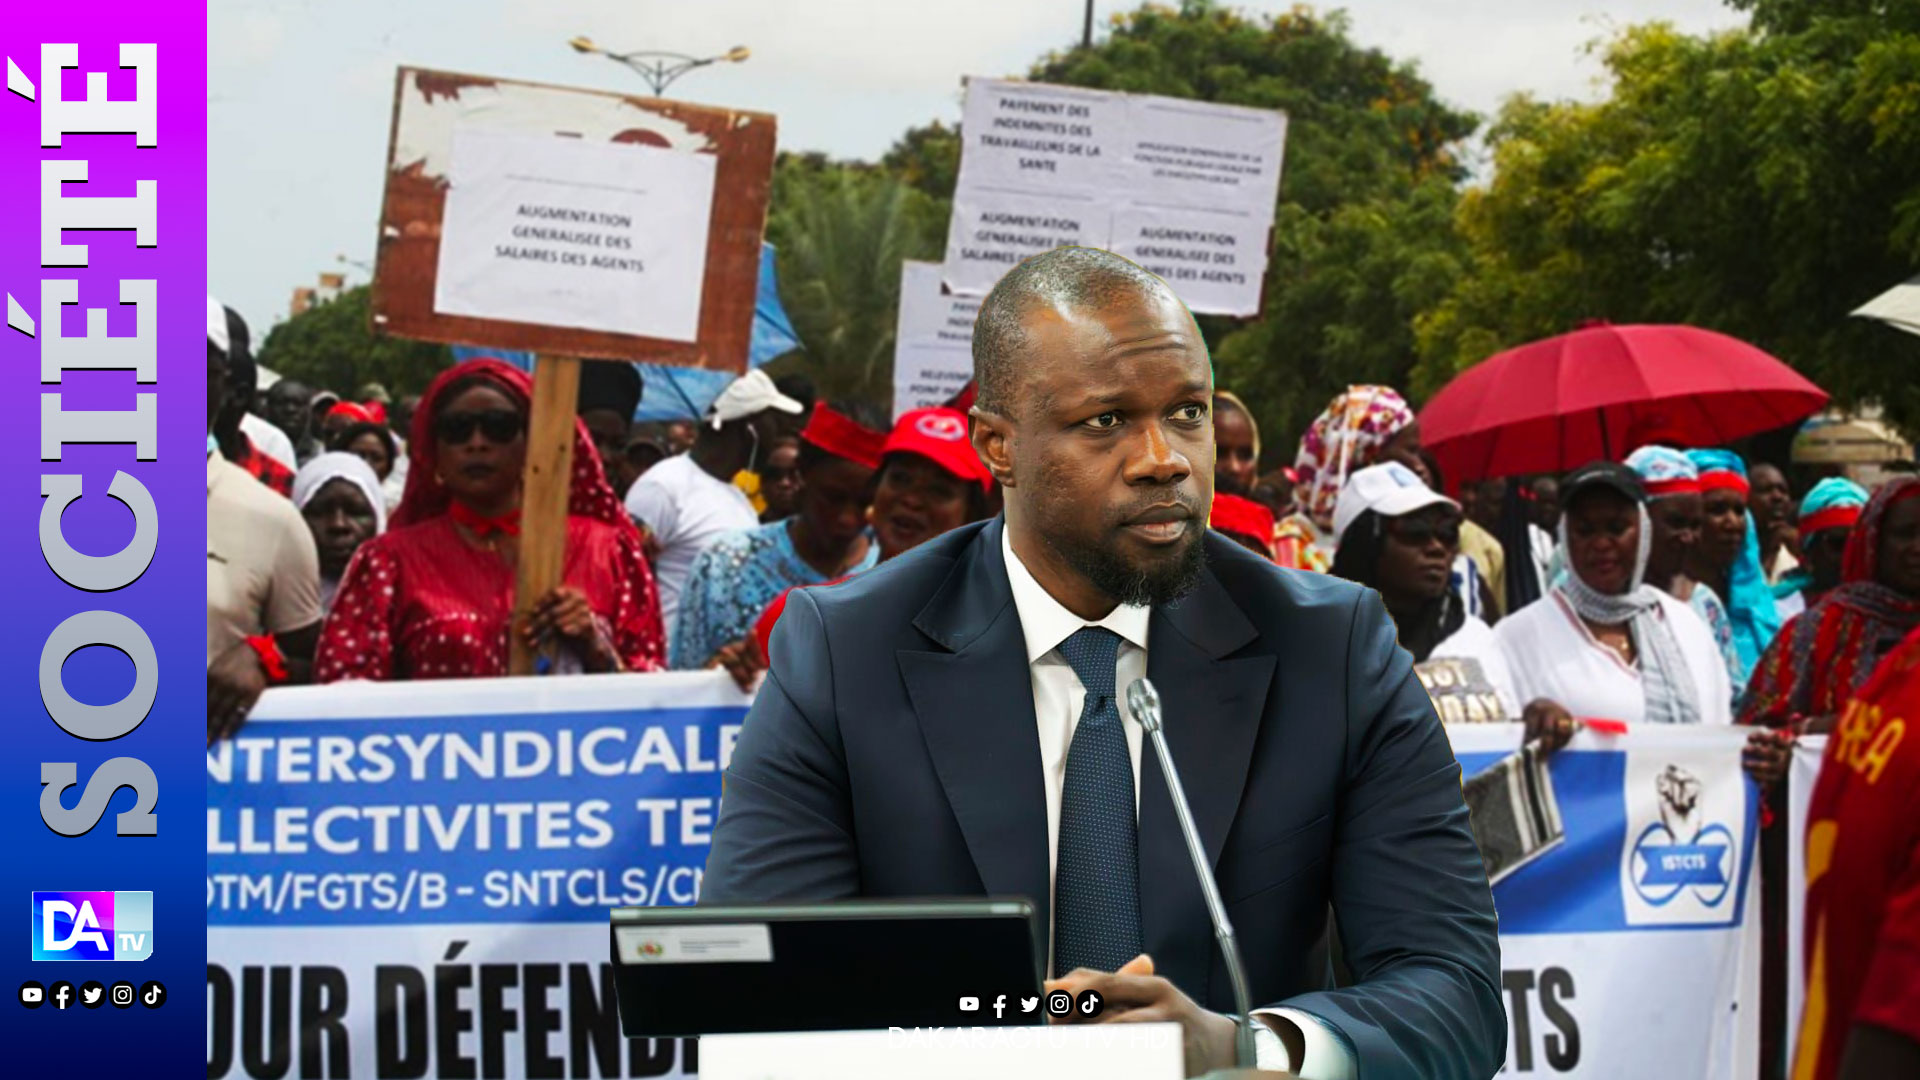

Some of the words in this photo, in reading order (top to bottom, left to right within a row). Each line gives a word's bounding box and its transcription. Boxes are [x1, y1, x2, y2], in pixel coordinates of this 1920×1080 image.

[1000, 98, 1064, 114] PAYEMENT
[1067, 104, 1090, 118] DES
[993, 117, 1066, 134] INDEMNITES
[1069, 124, 1092, 137] DES
[980, 134, 1065, 154] TRAVAILLEURS
[1067, 143, 1082, 156] DE
[1085, 145, 1101, 157] LA
[1019, 157, 1056, 172] SANTE
[517, 204, 632, 228] AUGMENTATION
[981, 212, 1079, 231] AUGMENTATION
[512, 225, 601, 247] GENERALISEE
[605, 235, 632, 249] DES
[975, 230, 1053, 248] GENERALISEE
[1140, 227, 1236, 245] AUGMENTATION
[495, 245, 557, 263] SALAIRES
[561, 251, 587, 266] DES
[590, 255, 644, 273] AGENTS
[961, 247, 1014, 263] SALAIRES
[1135, 246, 1210, 263] GENERALISEE
[1213, 252, 1235, 265] DES
[1176, 267, 1197, 280] DES
[1201, 269, 1246, 285] AGENTS
[207, 799, 614, 853] LLECTIVITES
[637, 797, 722, 845] TE
[1500, 966, 1581, 1073] TS
